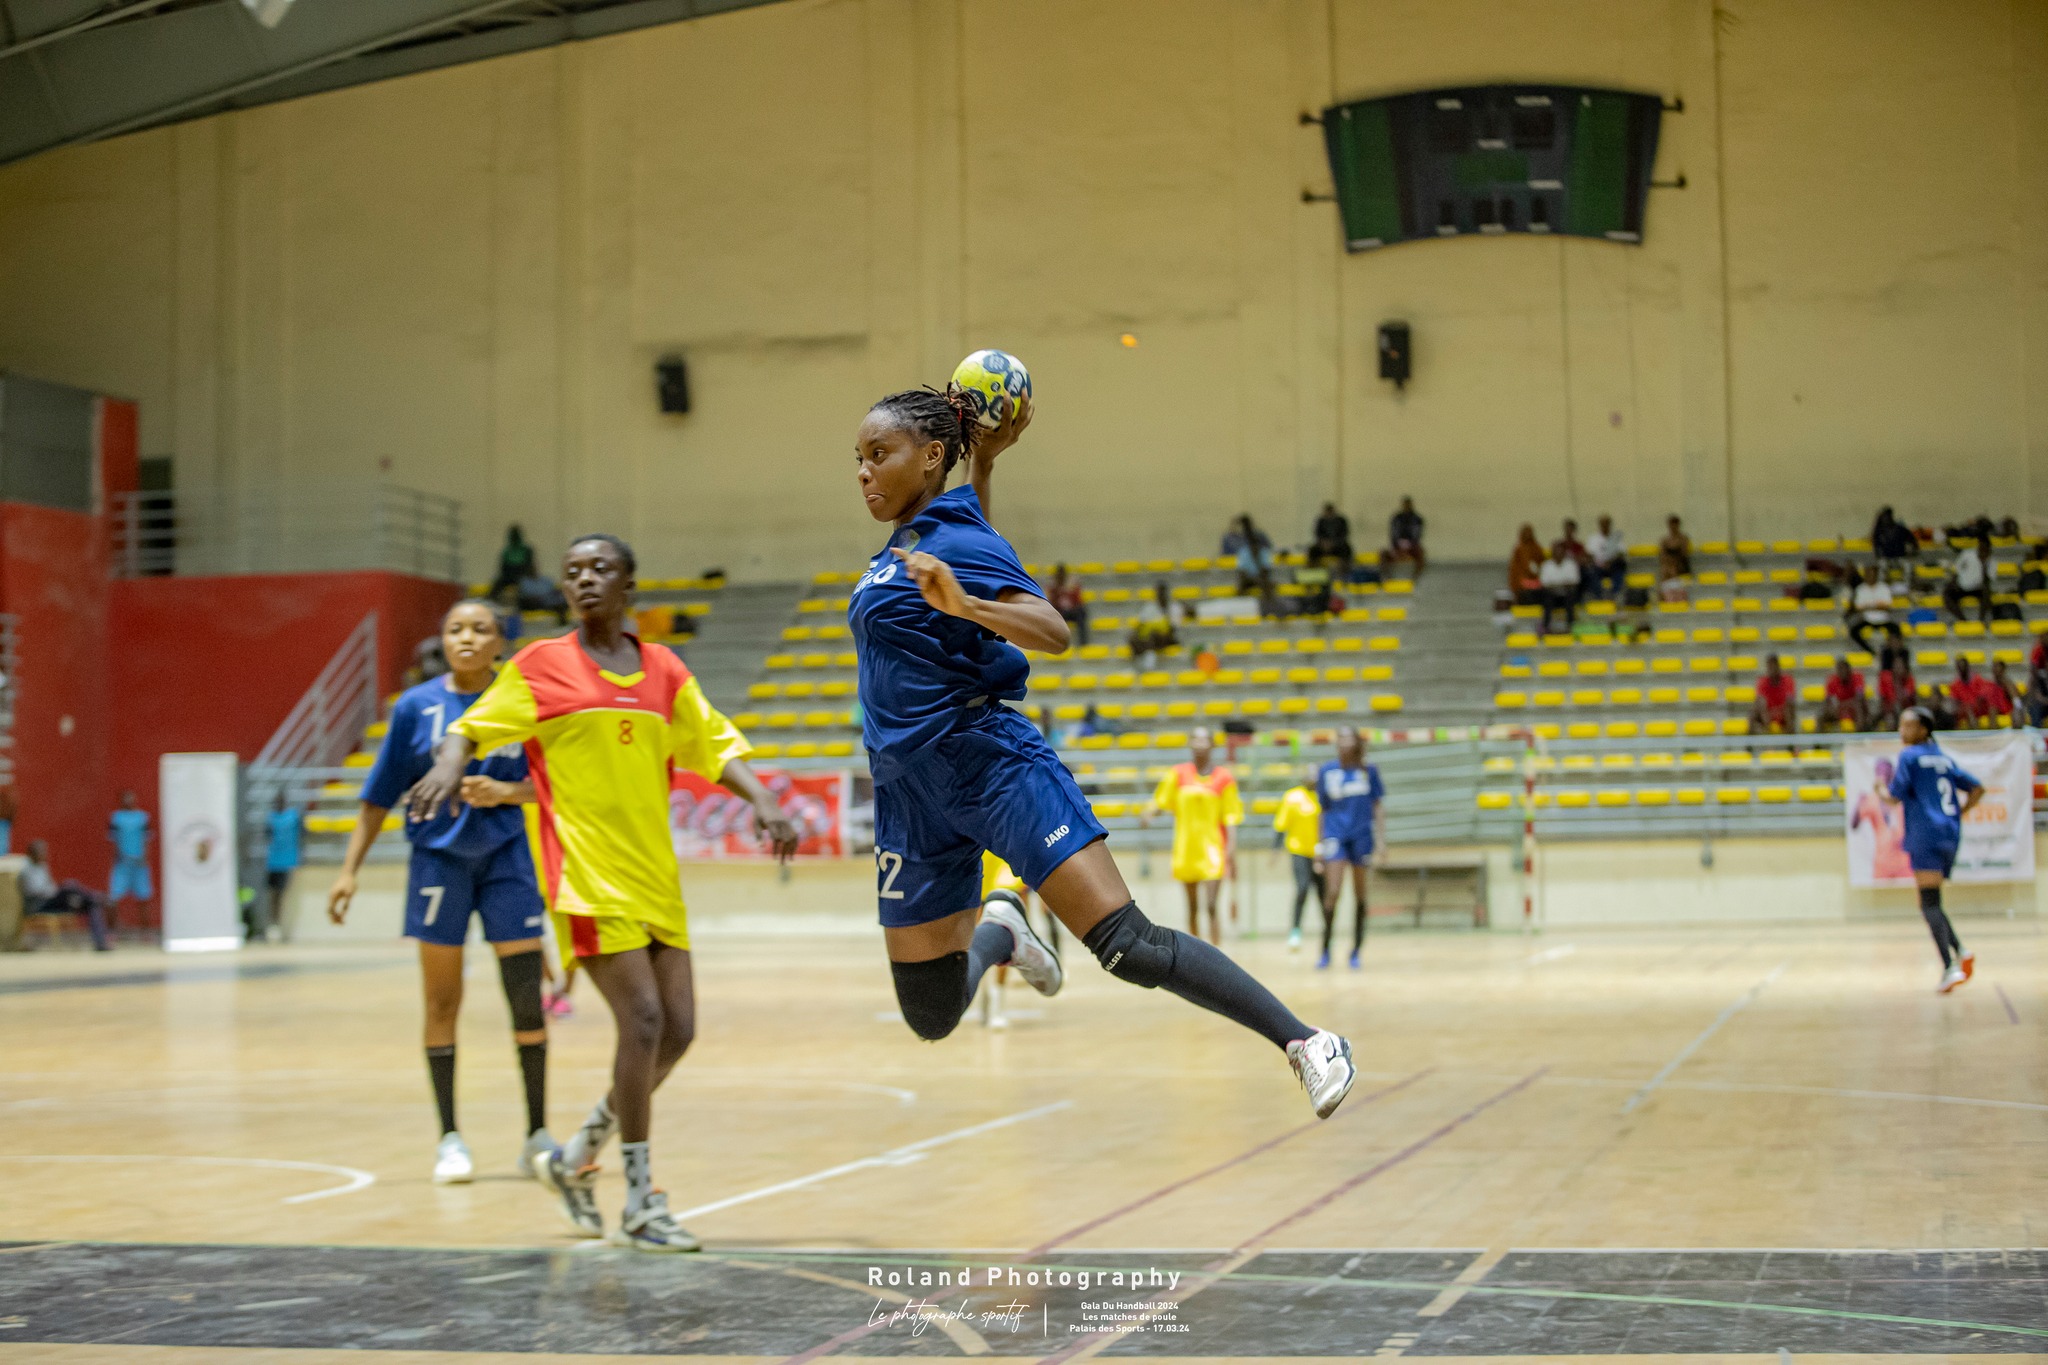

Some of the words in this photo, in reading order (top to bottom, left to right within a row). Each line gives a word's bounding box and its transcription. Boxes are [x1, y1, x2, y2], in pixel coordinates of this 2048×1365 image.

[618, 719, 634, 745] 8
[1044, 824, 1070, 848] JAKO
[874, 845, 905, 899] 2
[419, 886, 445, 926] 7
